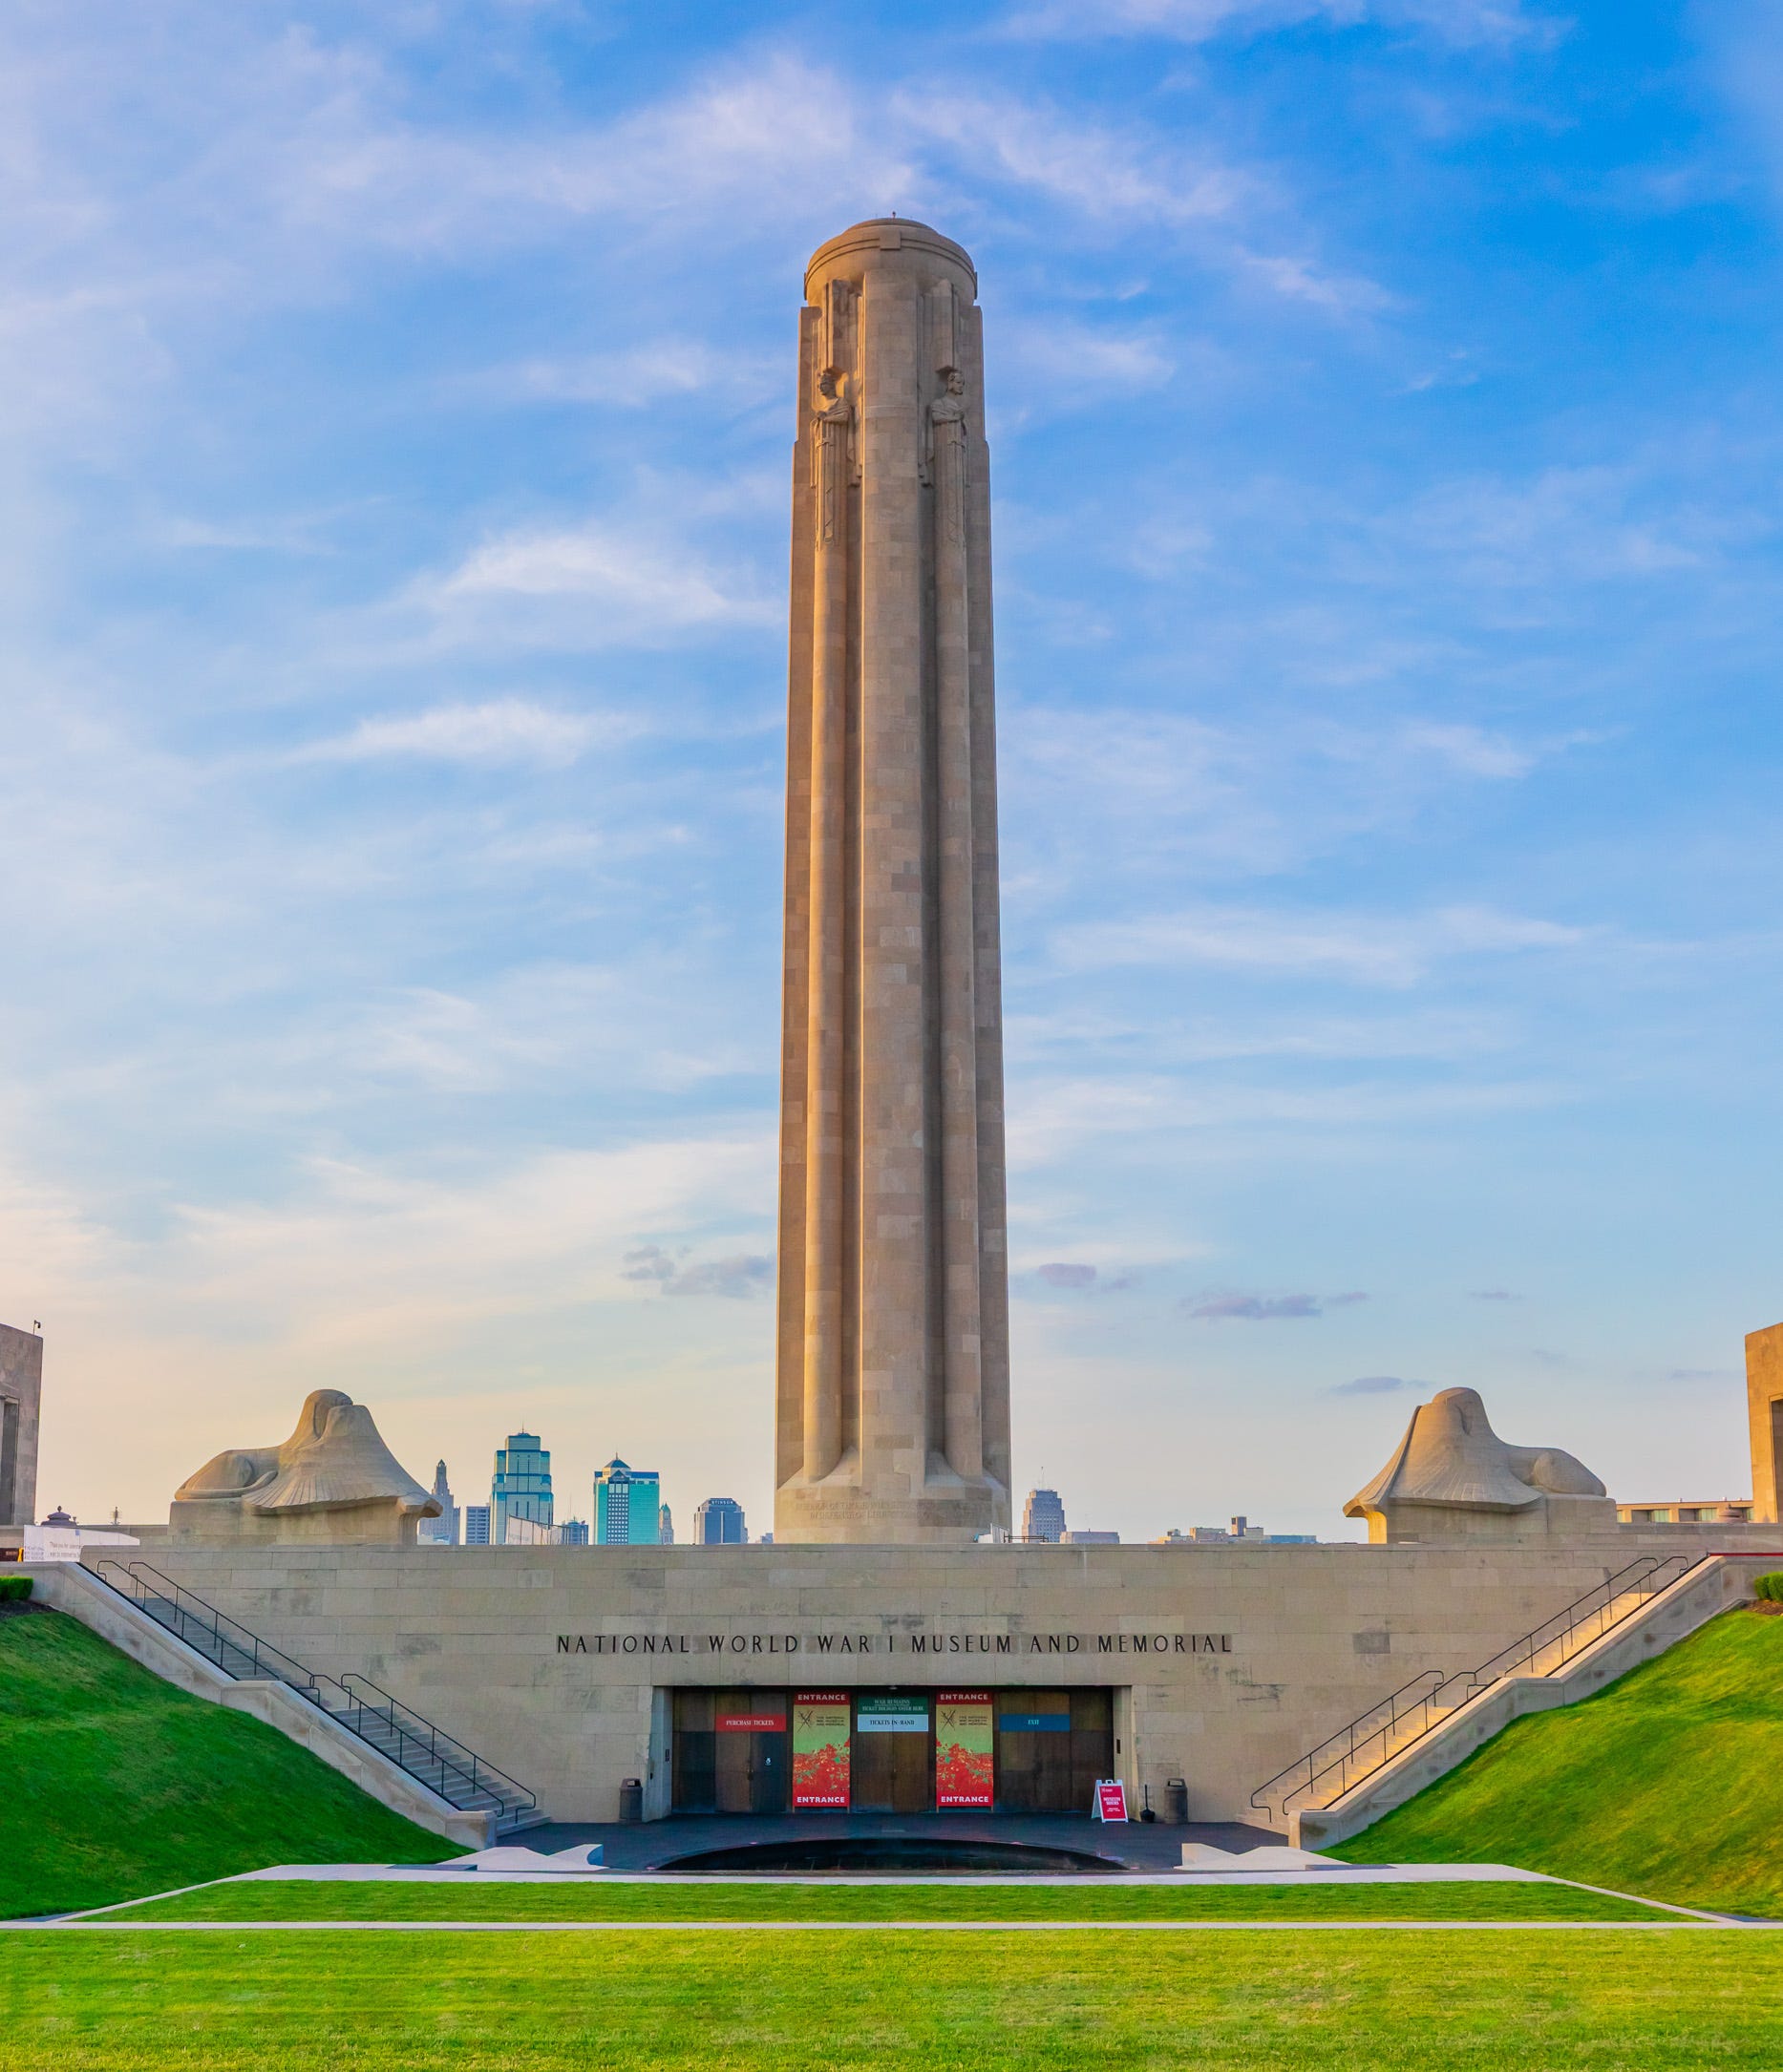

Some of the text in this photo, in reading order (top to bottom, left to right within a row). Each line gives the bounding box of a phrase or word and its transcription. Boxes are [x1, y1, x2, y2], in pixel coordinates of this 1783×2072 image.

[557, 1635, 1232, 1653] NATIONAL WORLD WAR I MUSEUM AND MEMORIAL
